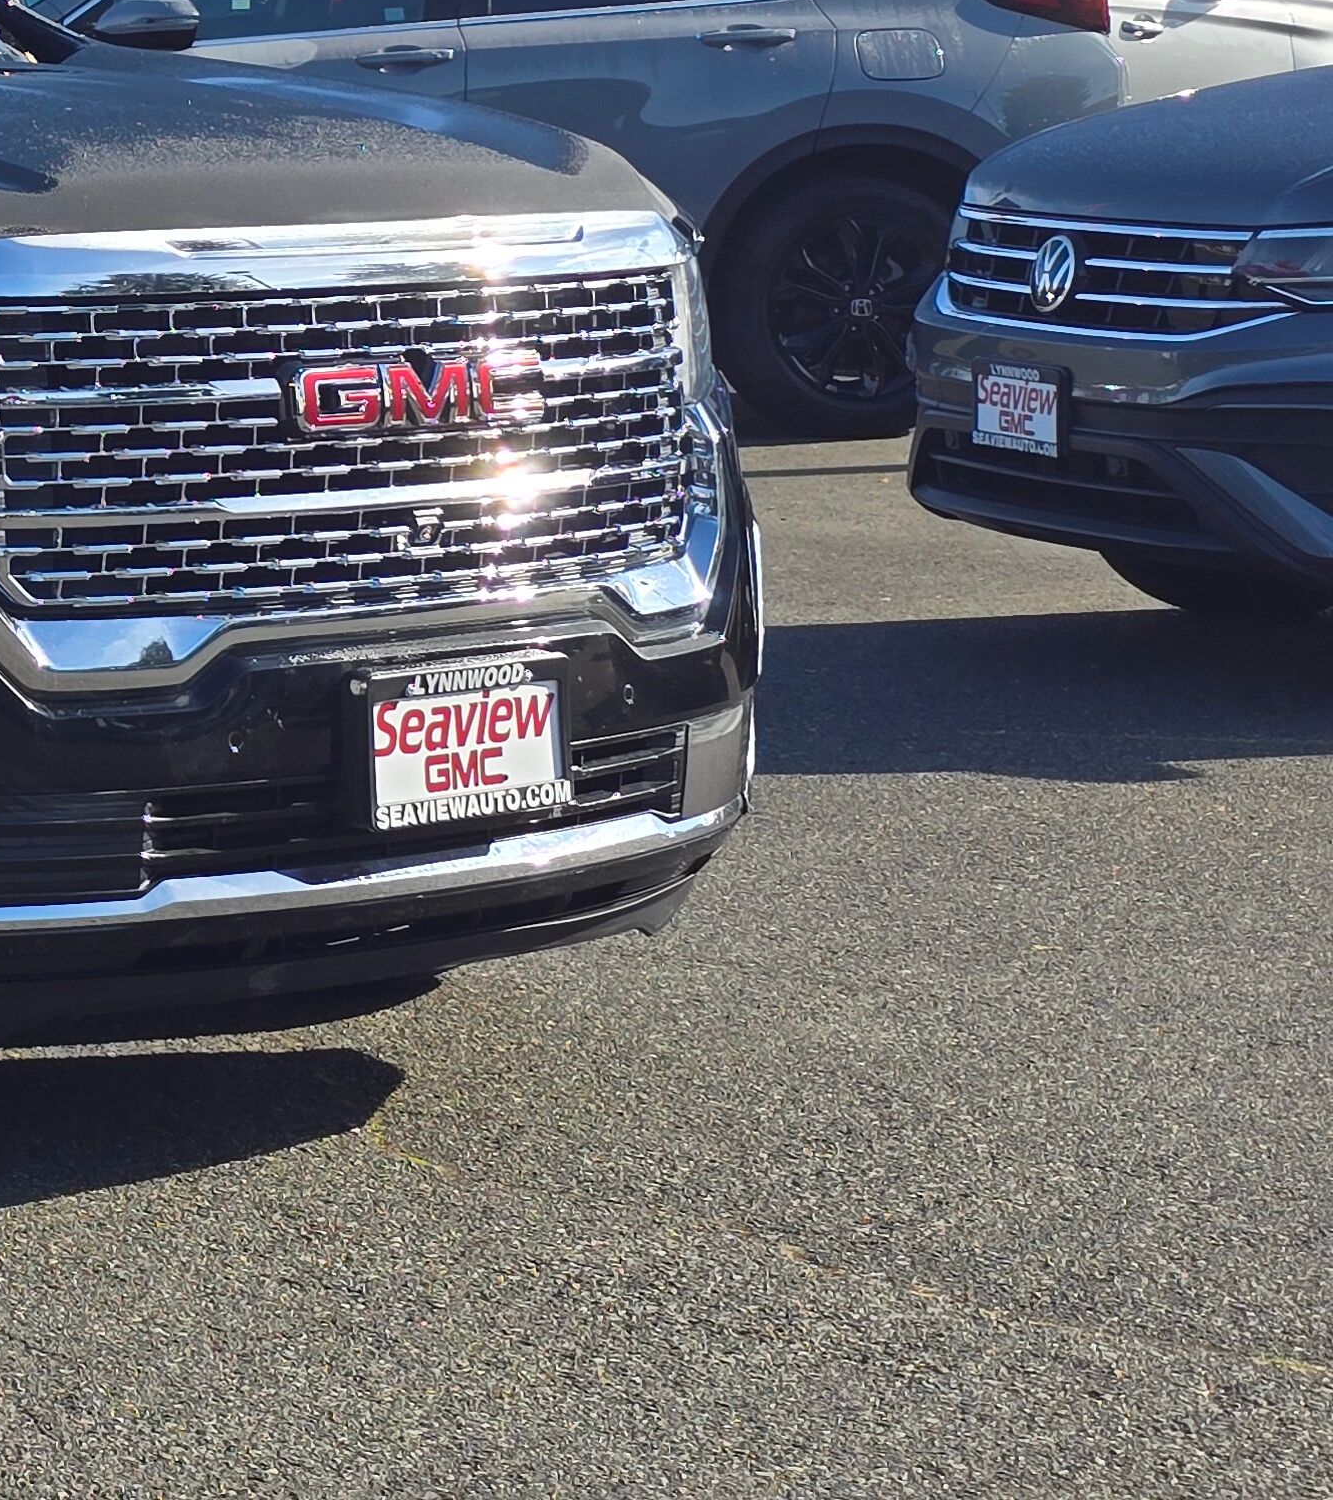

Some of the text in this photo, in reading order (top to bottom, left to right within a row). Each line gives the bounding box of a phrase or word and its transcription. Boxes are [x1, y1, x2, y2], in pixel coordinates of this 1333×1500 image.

[295, 349, 545, 433] GMC
[975, 373, 1057, 415] Seaview
[989, 363, 1040, 381] LYNNWOOD
[999, 409, 1035, 436] GMC
[413, 663, 525, 696] LYNNWOOD
[373, 690, 555, 757] Seaview
[424, 747, 508, 793] GMC
[376, 780, 573, 830] SEAVIEWAUTO.COM
